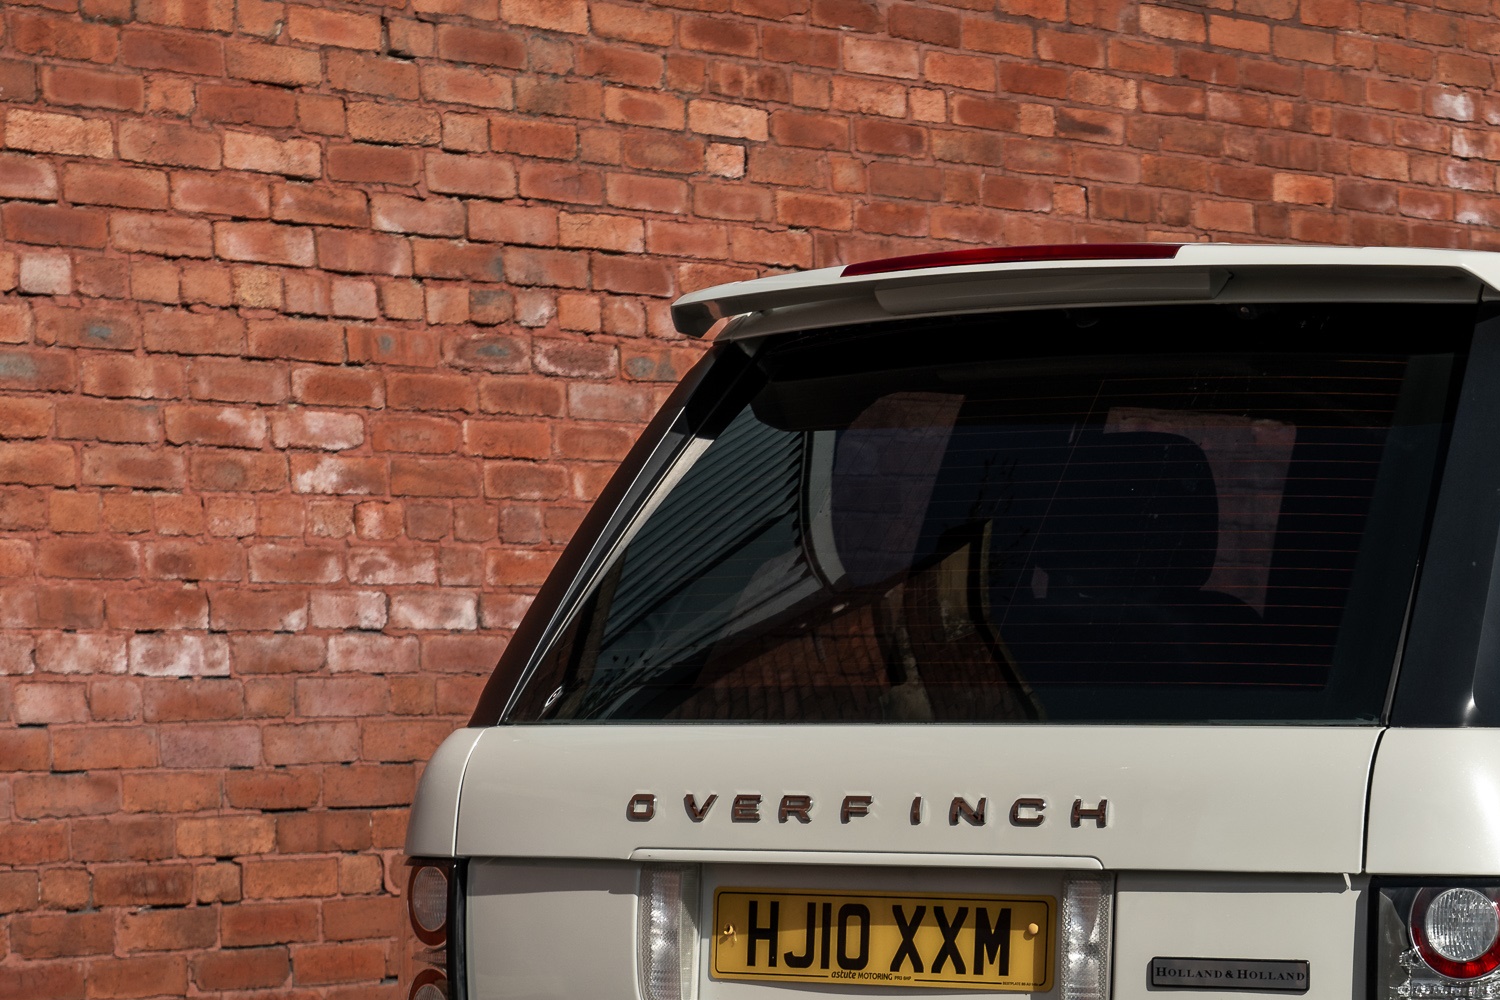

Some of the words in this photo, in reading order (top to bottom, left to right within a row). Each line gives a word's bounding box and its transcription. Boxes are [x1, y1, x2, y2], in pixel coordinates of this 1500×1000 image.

[626, 794, 1110, 828] OVERFINCH
[746, 900, 871, 970] HJ10
[889, 904, 1012, 976] XXM
[831, 970, 857, 979] astute
[857, 972, 893, 981] MOTORING
